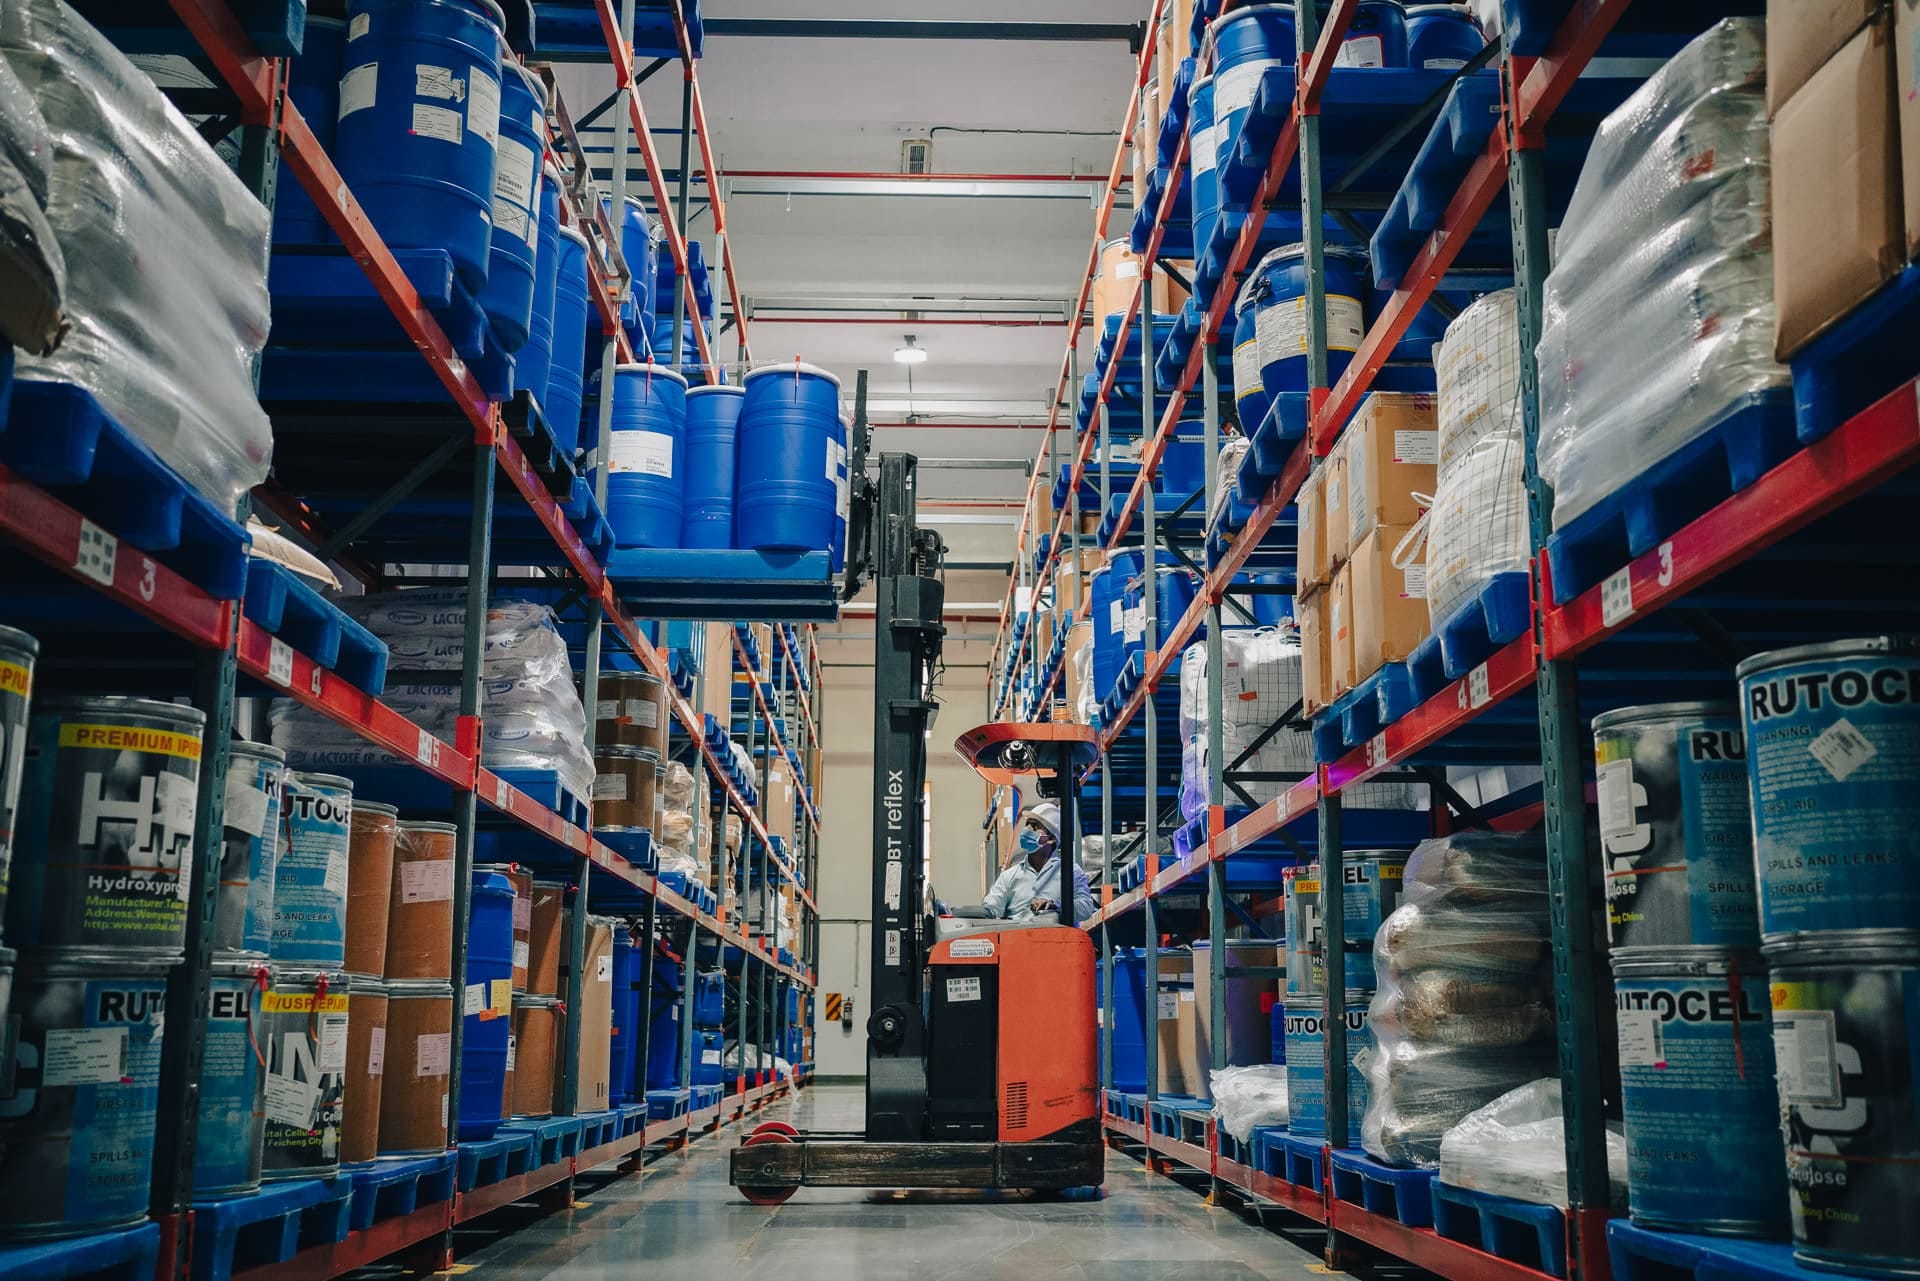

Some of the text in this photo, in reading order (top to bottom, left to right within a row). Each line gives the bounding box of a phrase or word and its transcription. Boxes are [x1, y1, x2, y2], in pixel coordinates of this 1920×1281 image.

[1657, 541, 1674, 587] 3
[139, 558, 157, 601] 3
[311, 666, 322, 698] 4
[406, 686, 453, 697] LACTOSE
[1457, 679, 1468, 709] 4
[76, 728, 173, 754] PREMIUM
[311, 751, 360, 765] LACTOSE
[363, 752, 375, 764] IP
[1365, 739, 1373, 768] 5
[883, 769, 903, 830] reflex
[888, 836, 902, 860] BT
[1767, 852, 1898, 872] SPILLS AND LEAKS
[280, 873, 297, 883] AID
[1300, 882, 1319, 893] PRE
[1769, 880, 1825, 897] STORAGE
[284, 912, 305, 922] AND
[307, 912, 333, 922] LEAKS
[1613, 990, 1764, 1022] UTOCEL
[90, 1151, 130, 1163] SPILLS
